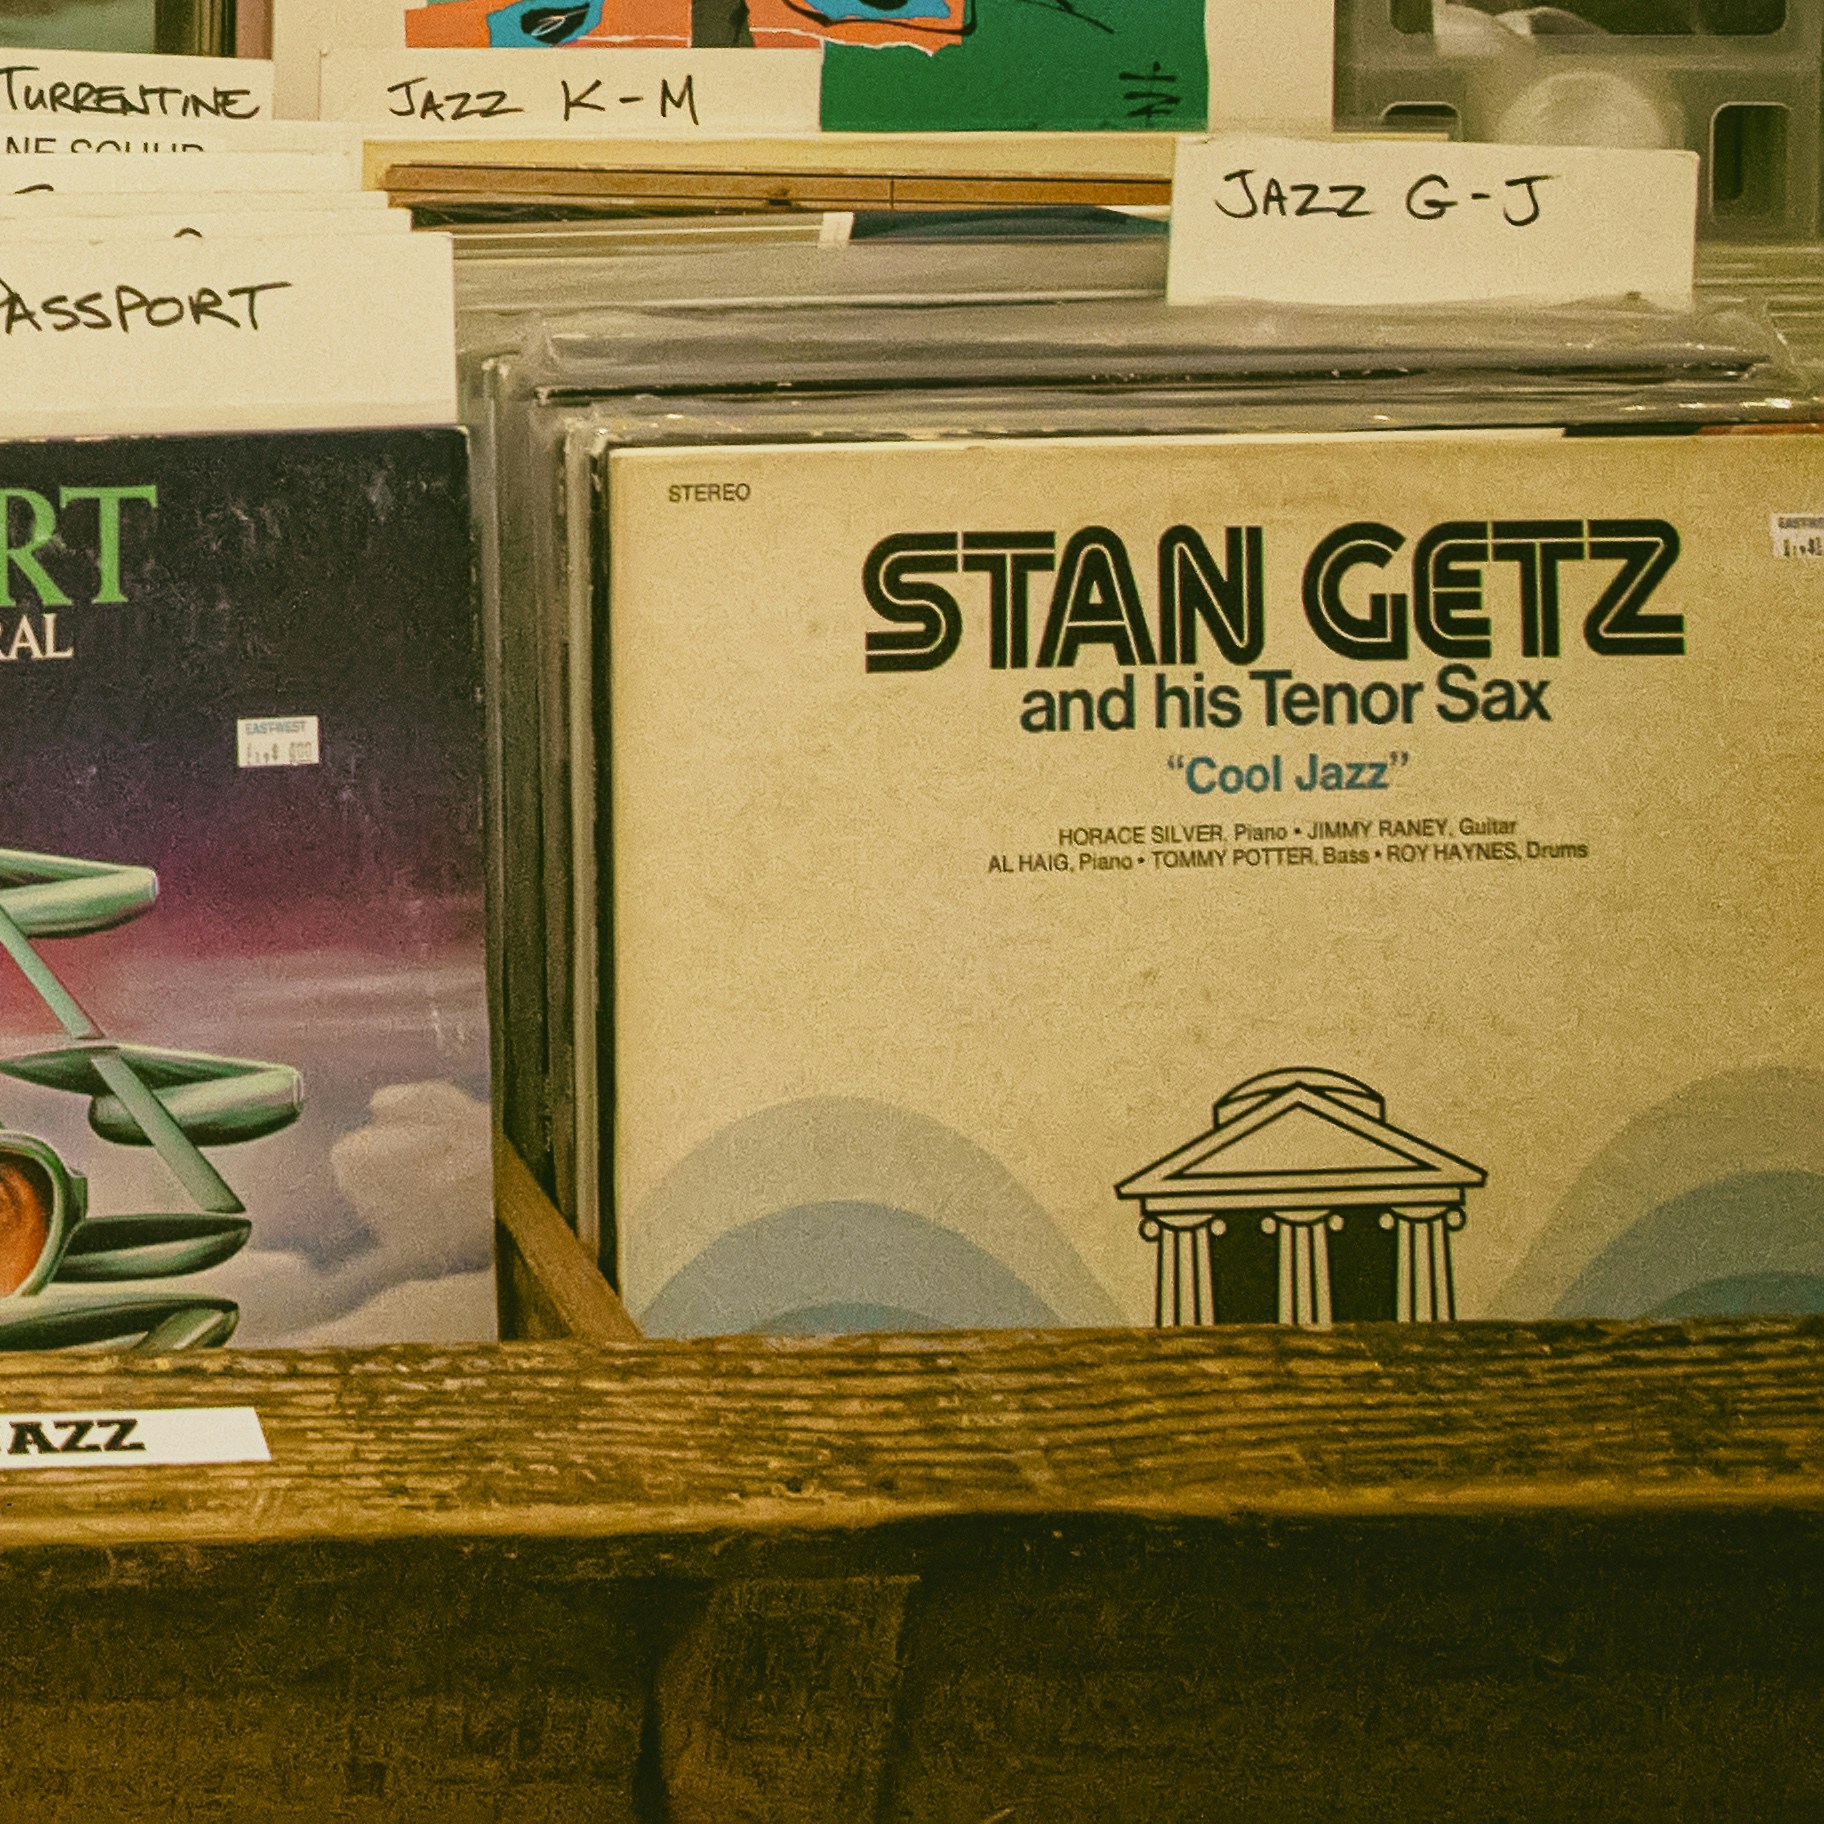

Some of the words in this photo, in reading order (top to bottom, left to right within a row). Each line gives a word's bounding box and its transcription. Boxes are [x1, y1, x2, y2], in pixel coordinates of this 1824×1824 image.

[387, 76, 524, 119] JAZZ
[560, 76, 698, 127] K-M
[1216, 167, 1373, 222] JAZZ
[1405, 170, 1556, 228] G-J
[667, 480, 752, 506] STEREO
[863, 523, 1266, 675] STAN
[1302, 520, 1686, 663] GETZ
[1019, 673, 1137, 733] and
[1153, 668, 1243, 731] his
[1249, 670, 1426, 730] Tenor
[1434, 663, 1554, 725] Sax
[987, 854, 1014, 874] AL
[1017, 853, 1075, 875] HAIG,
[1078, 851, 1133, 872] Piano
[1152, 848, 1227, 869] TOMMY
[1322, 845, 1371, 865] Bass
[1386, 843, 1427, 864] ROY
[1526, 839, 1590, 860] Drums
[1058, 826, 1145, 847] HORACE
[1233, 822, 1289, 842] Piano
[1306, 821, 1374, 841] JIMMY
[1459, 816, 1518, 837] Guitar
